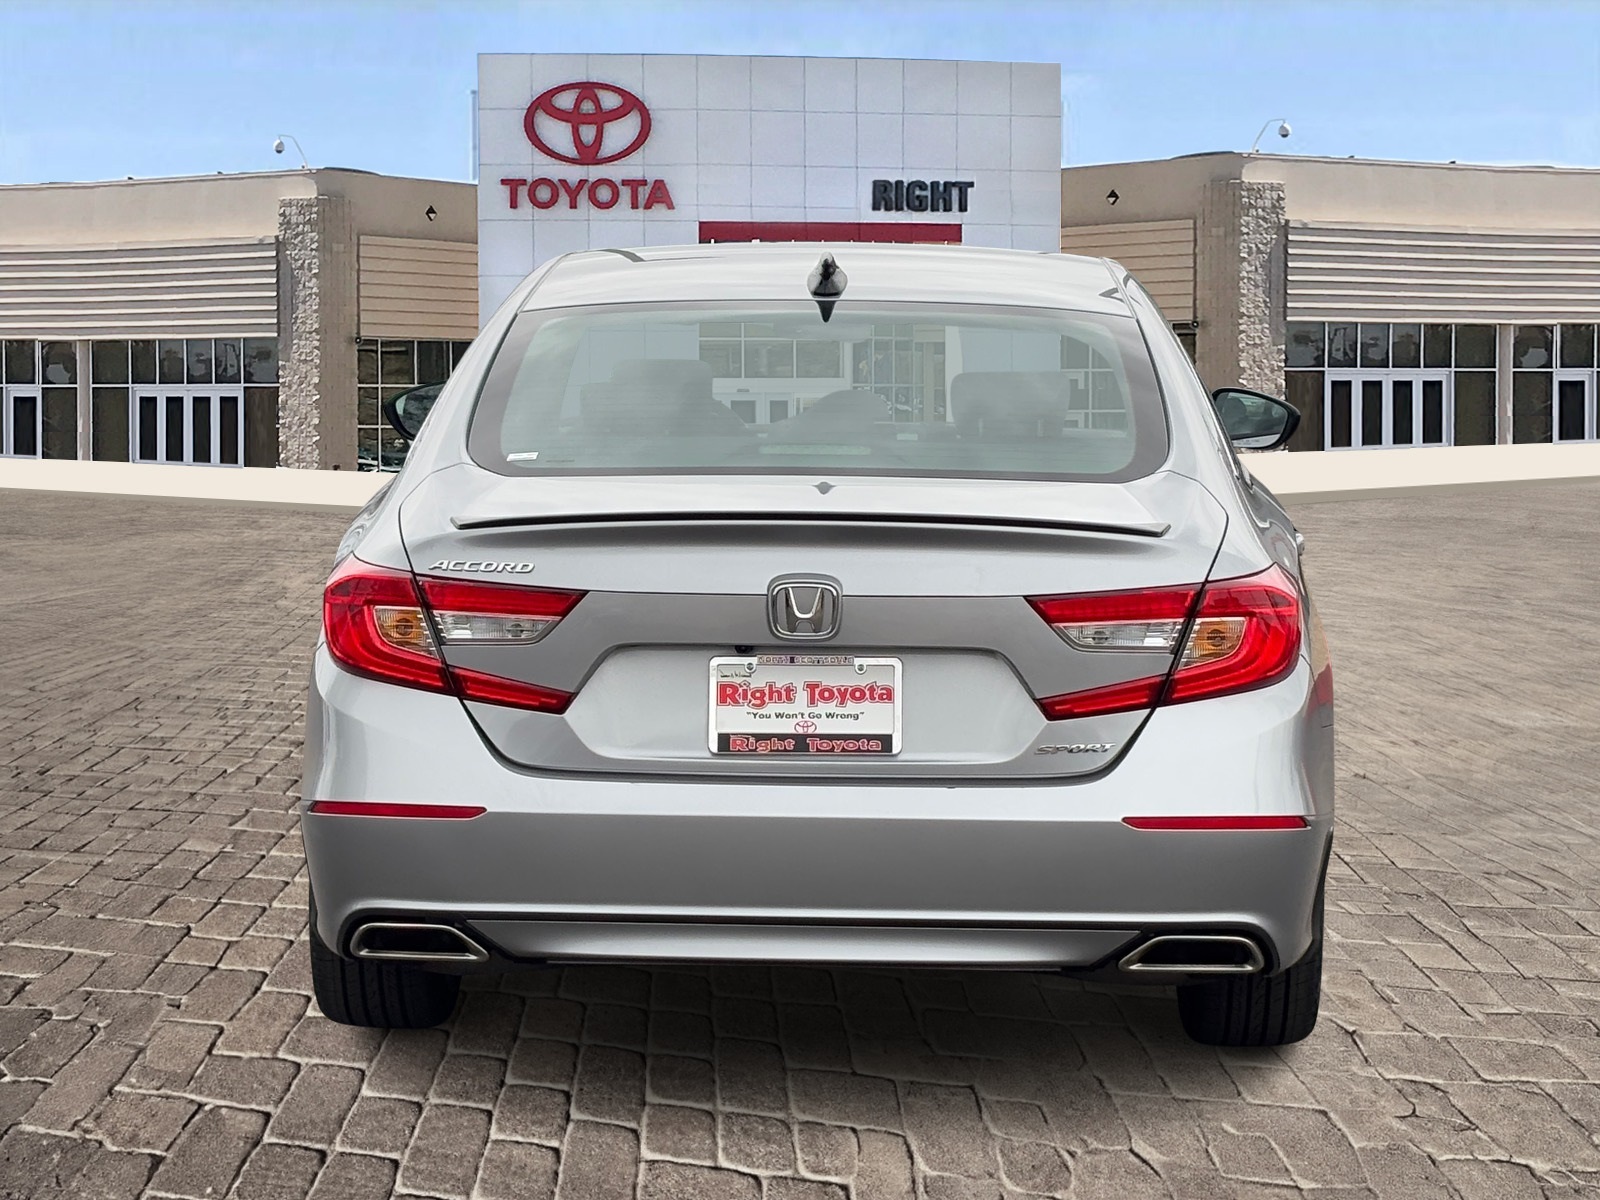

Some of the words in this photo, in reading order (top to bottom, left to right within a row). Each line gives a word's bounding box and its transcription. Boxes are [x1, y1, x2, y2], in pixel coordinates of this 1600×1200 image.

[500, 178, 675, 210] TOYOTA
[872, 180, 975, 213] RIGHT
[428, 559, 535, 574] ACCORD
[717, 680, 797, 710] Right
[804, 680, 894, 707] Toyota
[775, 711, 805, 720] Won't
[808, 711, 822, 720] Go
[730, 737, 795, 753] Right
[806, 737, 882, 752] Toyota
[1034, 743, 1116, 755] SPORT
